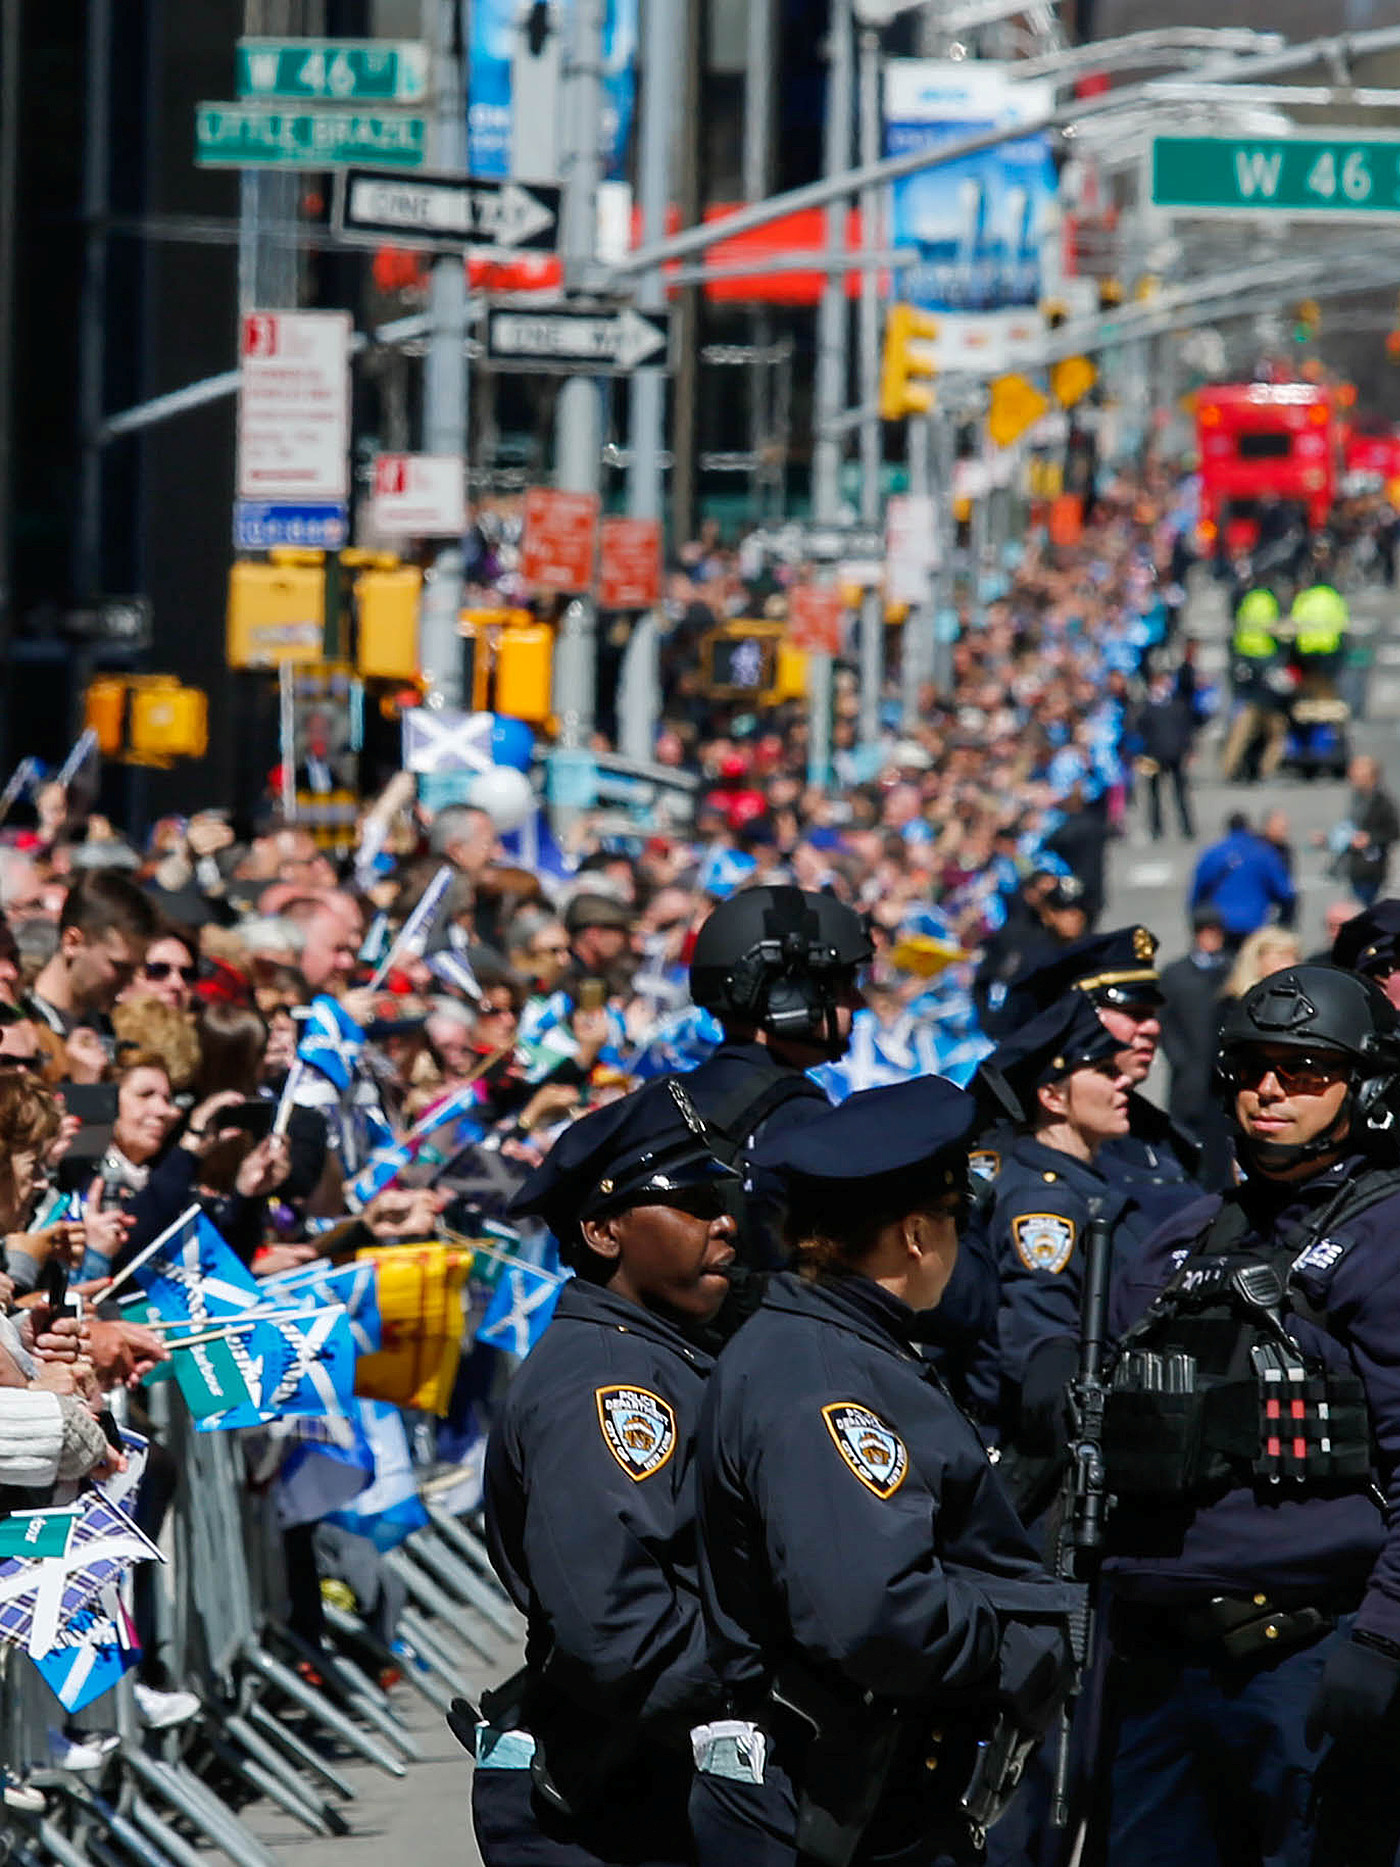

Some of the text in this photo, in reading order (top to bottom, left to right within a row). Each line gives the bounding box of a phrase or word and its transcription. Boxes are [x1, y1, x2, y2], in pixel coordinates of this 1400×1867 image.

[298, 51, 356, 94] 46
[1235, 150, 1282, 198] W
[1308, 151, 1372, 201] 46
